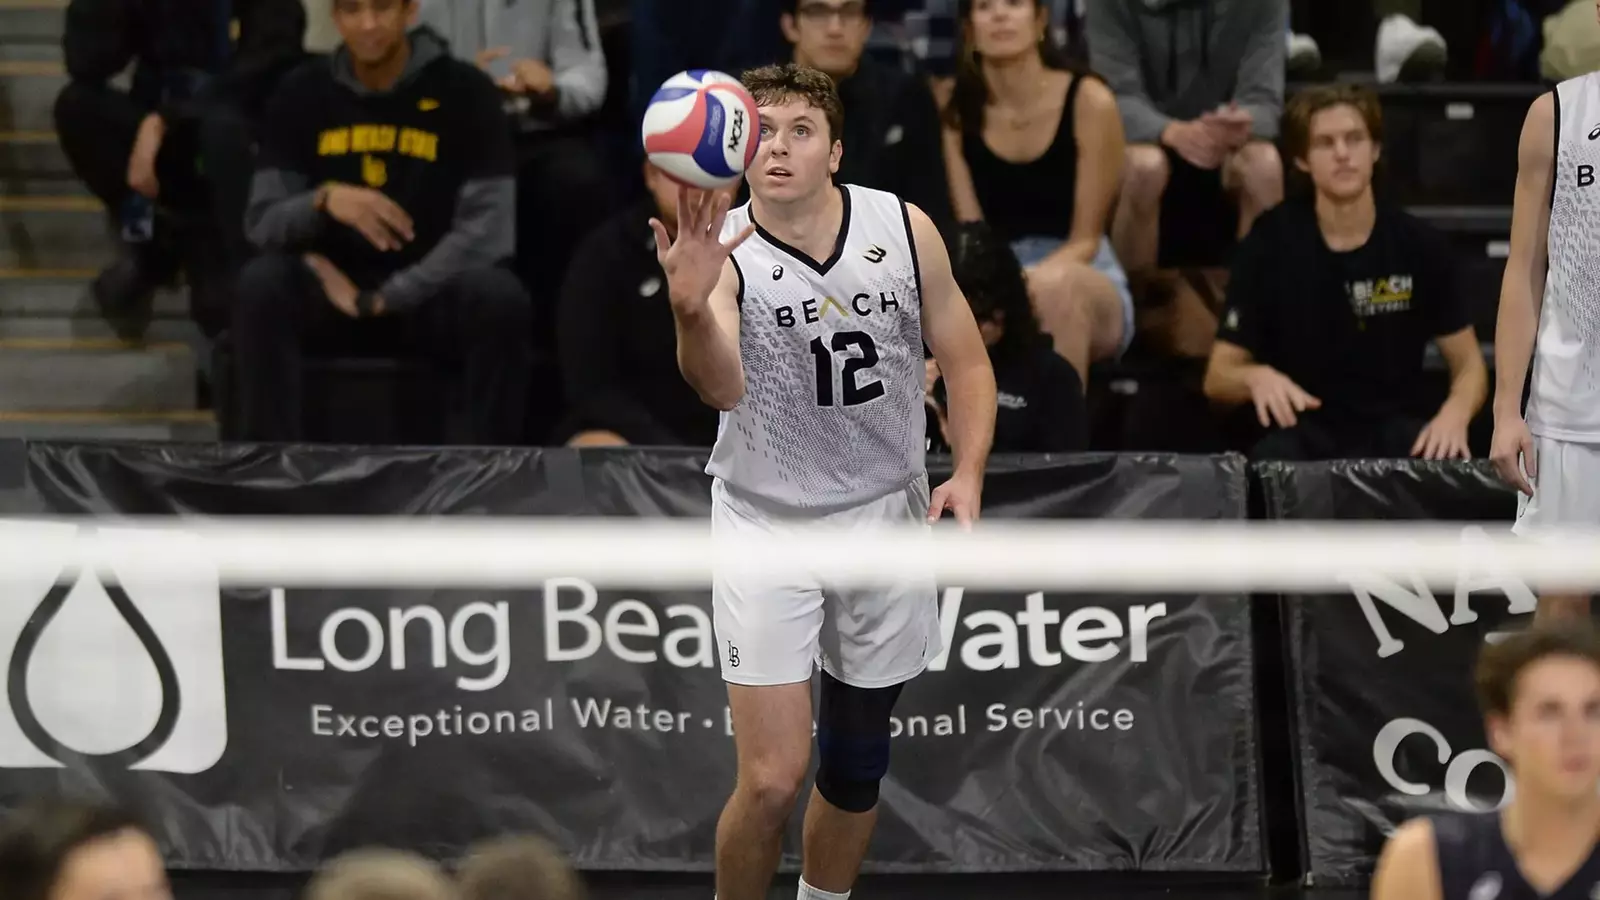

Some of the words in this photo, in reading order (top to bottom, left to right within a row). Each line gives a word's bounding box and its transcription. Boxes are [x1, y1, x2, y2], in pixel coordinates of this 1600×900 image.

[727, 106, 743, 153] NCAA
[775, 292, 900, 328] BEACH
[810, 331, 885, 407] 12
[270, 586, 511, 691] Long
[543, 577, 714, 668] Bea
[311, 699, 553, 747] Exceptional
[571, 698, 691, 733] Water
[986, 702, 1136, 732] Service
